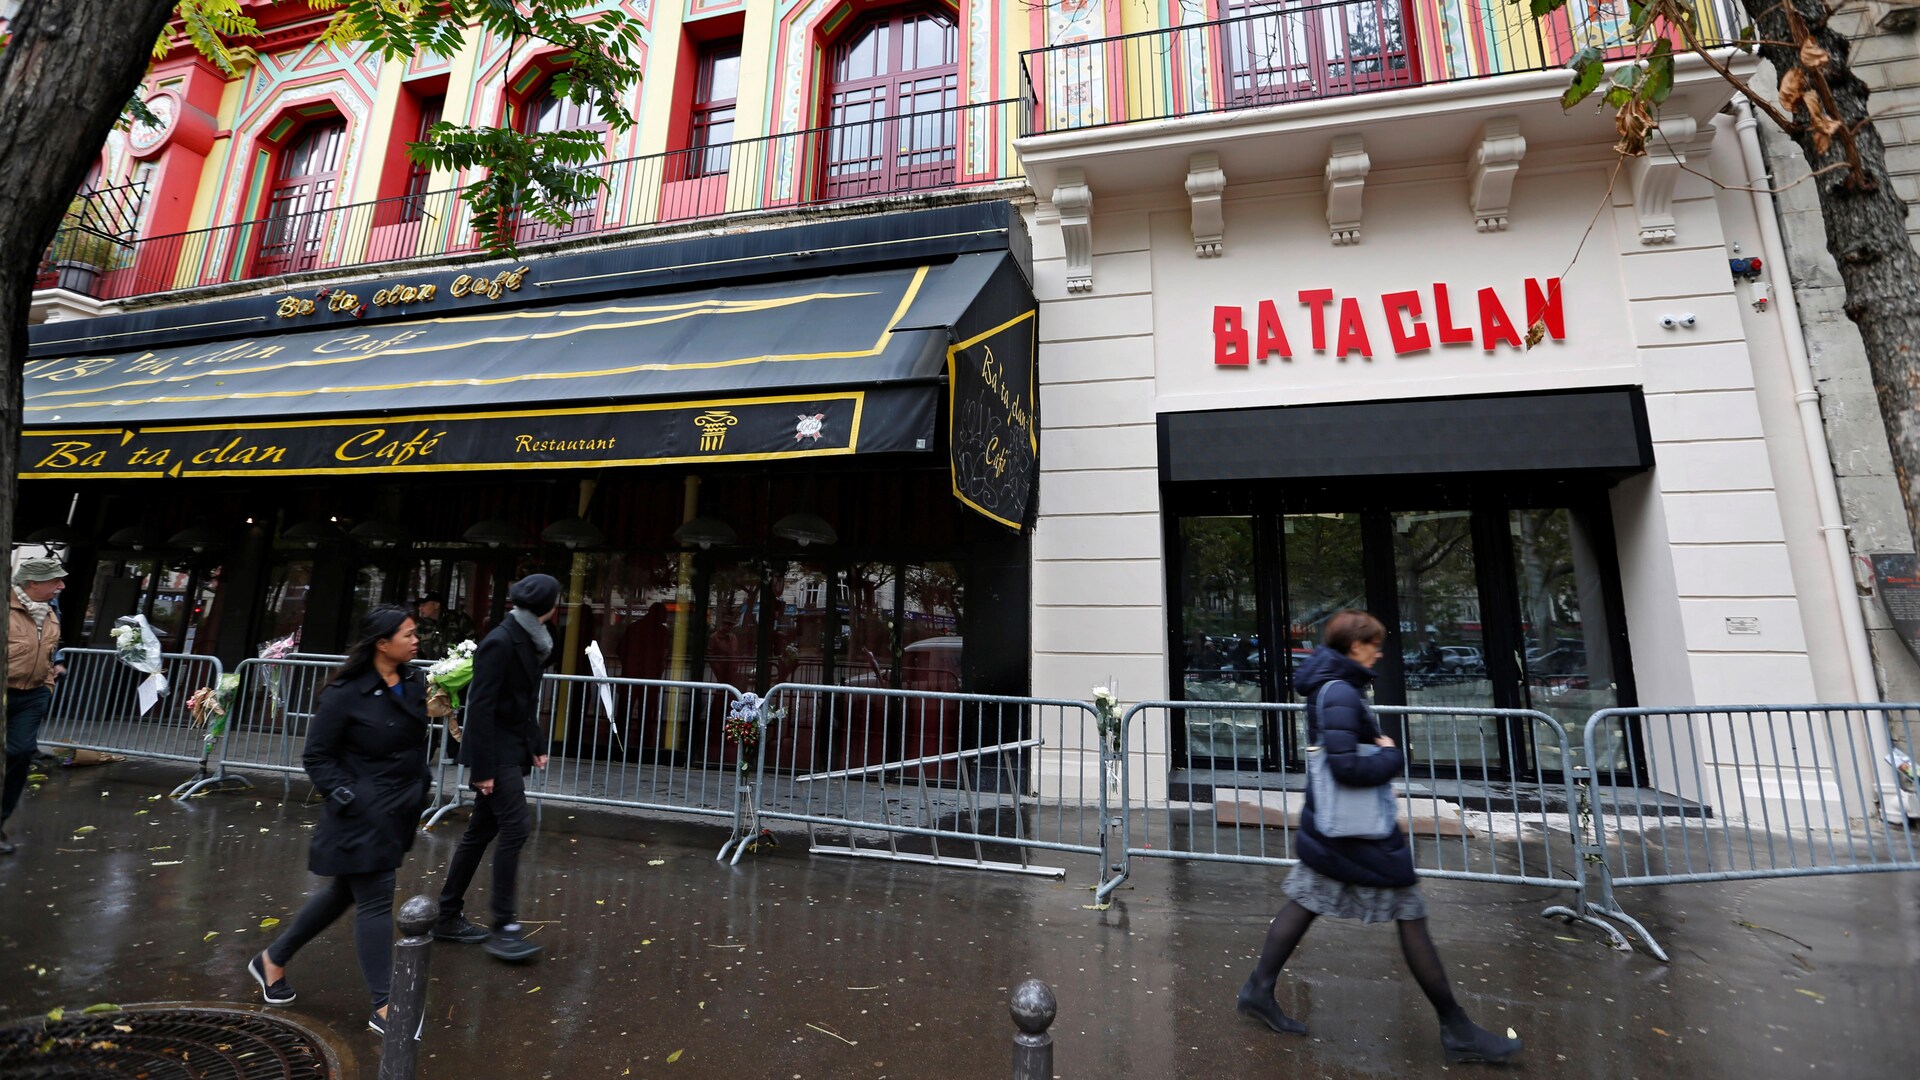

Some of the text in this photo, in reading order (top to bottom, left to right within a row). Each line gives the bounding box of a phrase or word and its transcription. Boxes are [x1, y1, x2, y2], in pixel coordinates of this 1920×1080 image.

[372, 283, 437, 307] clan
[449, 265, 530, 300] Café
[1213, 276, 1566, 368] BATACLAN
[312, 330, 428, 355] Café
[191, 436, 288, 465] clan
[334, 427, 448, 466] Café
[514, 433, 617, 454] Restaurant
